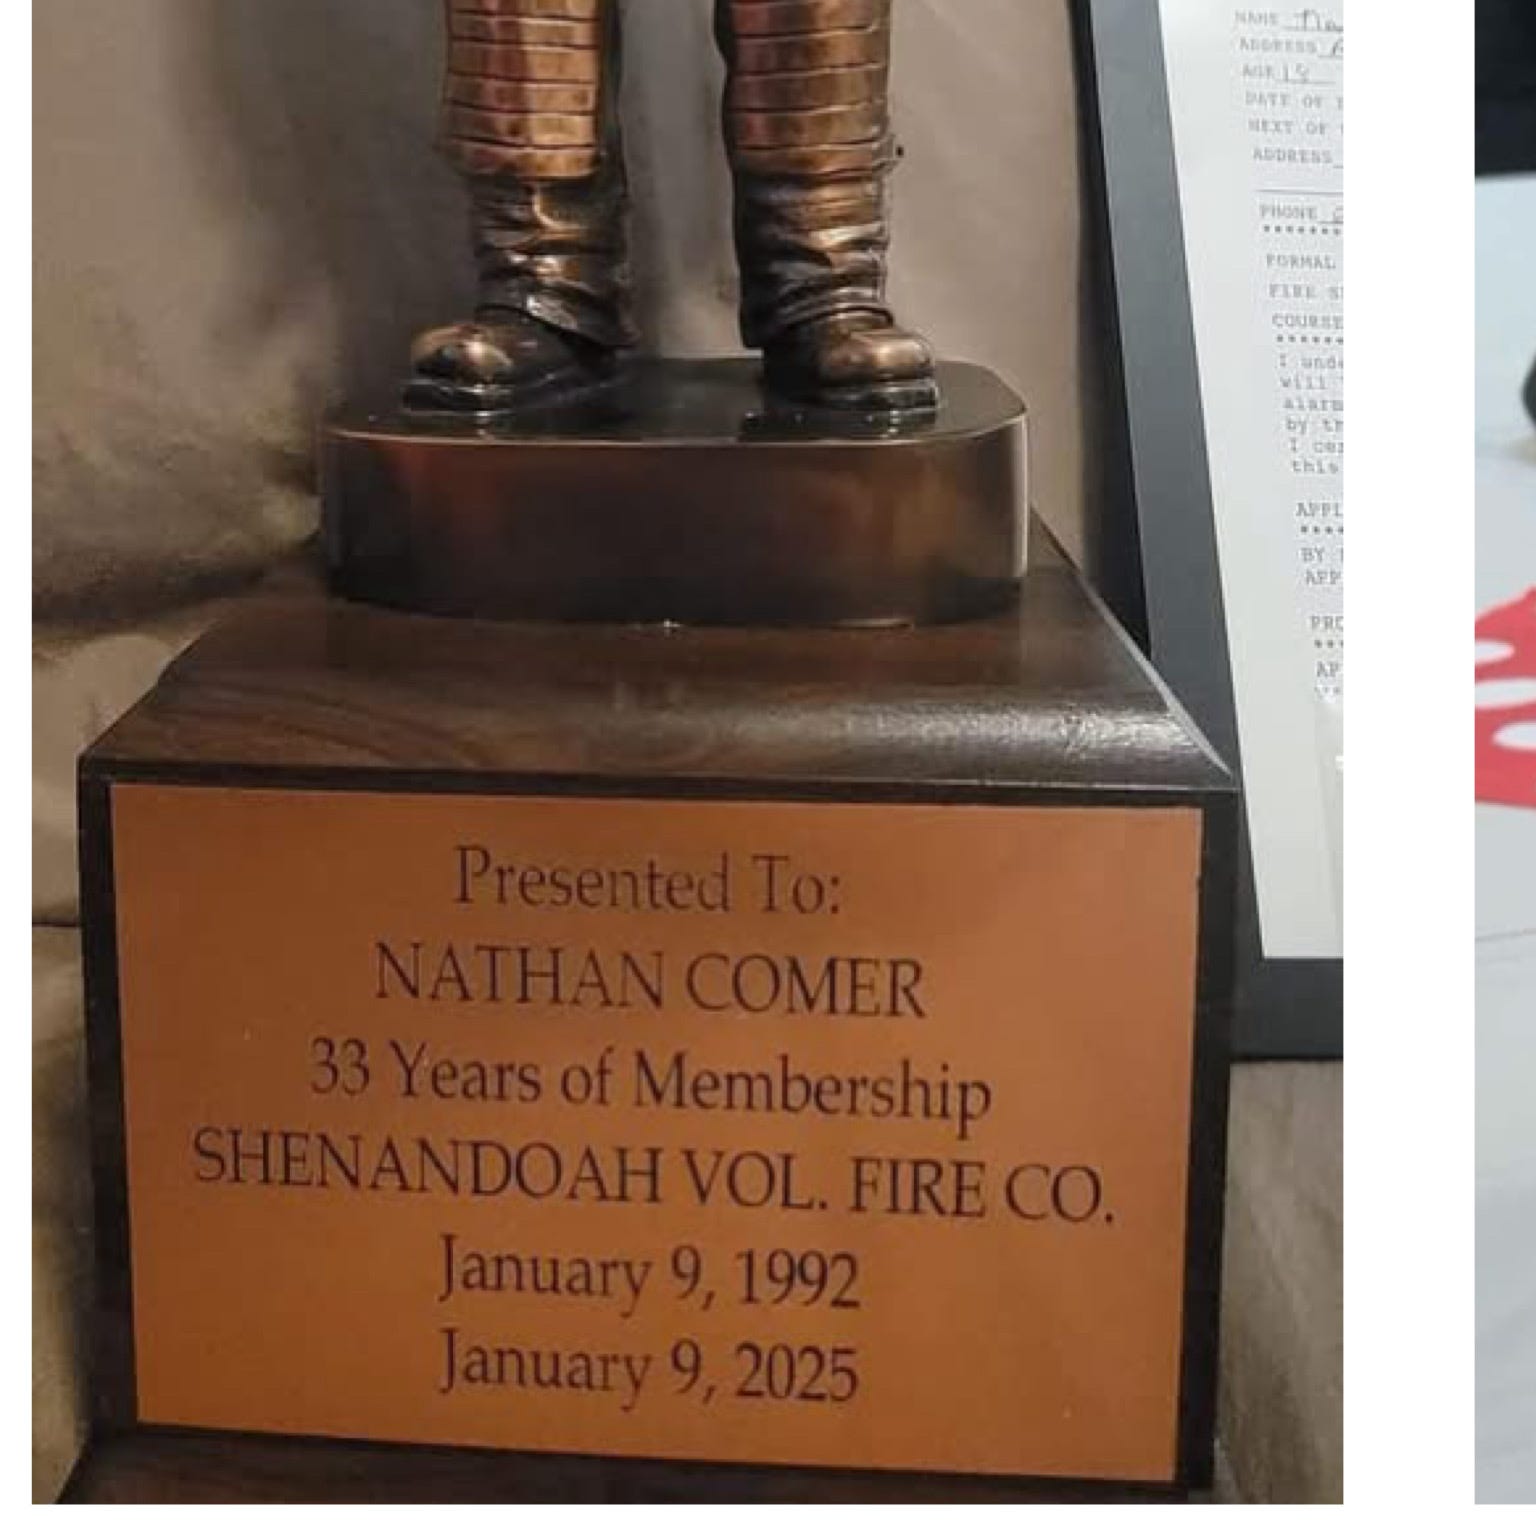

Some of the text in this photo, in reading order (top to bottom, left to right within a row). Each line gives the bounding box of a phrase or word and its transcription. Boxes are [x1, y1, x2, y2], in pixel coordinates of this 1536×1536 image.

[1240, 37, 1317, 54] ADDRESS
[1253, 147, 1333, 164] ADDRESS
[1260, 204, 1318, 220] PHONE
[454, 843, 841, 916] Presented To:
[374, 940, 927, 1020] NATHAN COMER
[311, 1035, 993, 1143] 33 Years of Membership
[192, 1125, 1115, 1226] SHENANDOAH VOL. FIRE CO.
[437, 1232, 862, 1320] January 9, 1992
[438, 1326, 861, 1414] January 9, 2025
